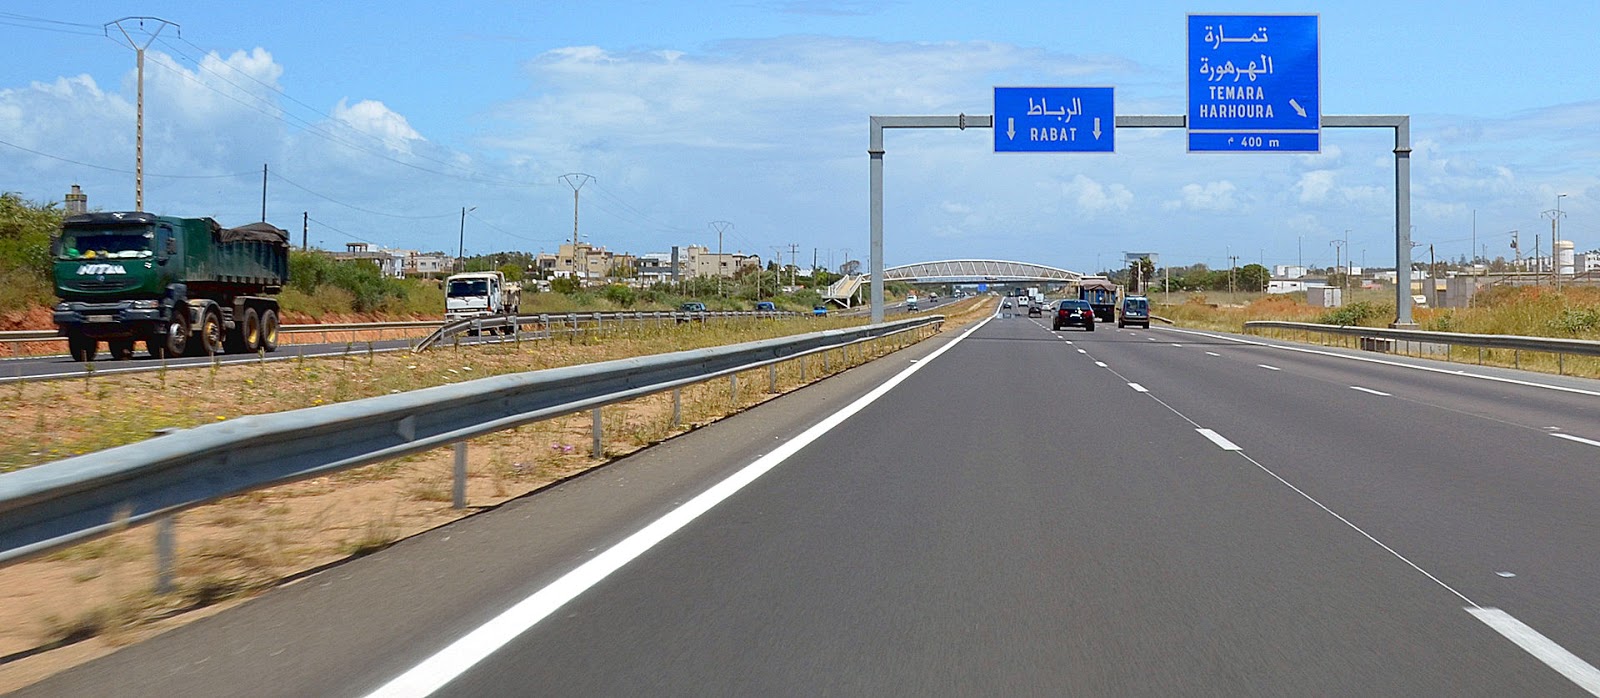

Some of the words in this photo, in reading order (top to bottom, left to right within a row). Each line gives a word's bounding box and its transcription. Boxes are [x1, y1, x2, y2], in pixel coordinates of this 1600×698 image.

[1204, 24, 1269, 50] تمارة
[1199, 54, 1273, 82] الهرهورة
[1209, 86, 1265, 100] TEMARA
[1027, 97, 1082, 123] الرباط
[1199, 104, 1274, 118] HARHOURA
[1030, 127, 1077, 142] RABAT
[1241, 136, 1262, 147] 400
[1268, 139, 1280, 147] m
